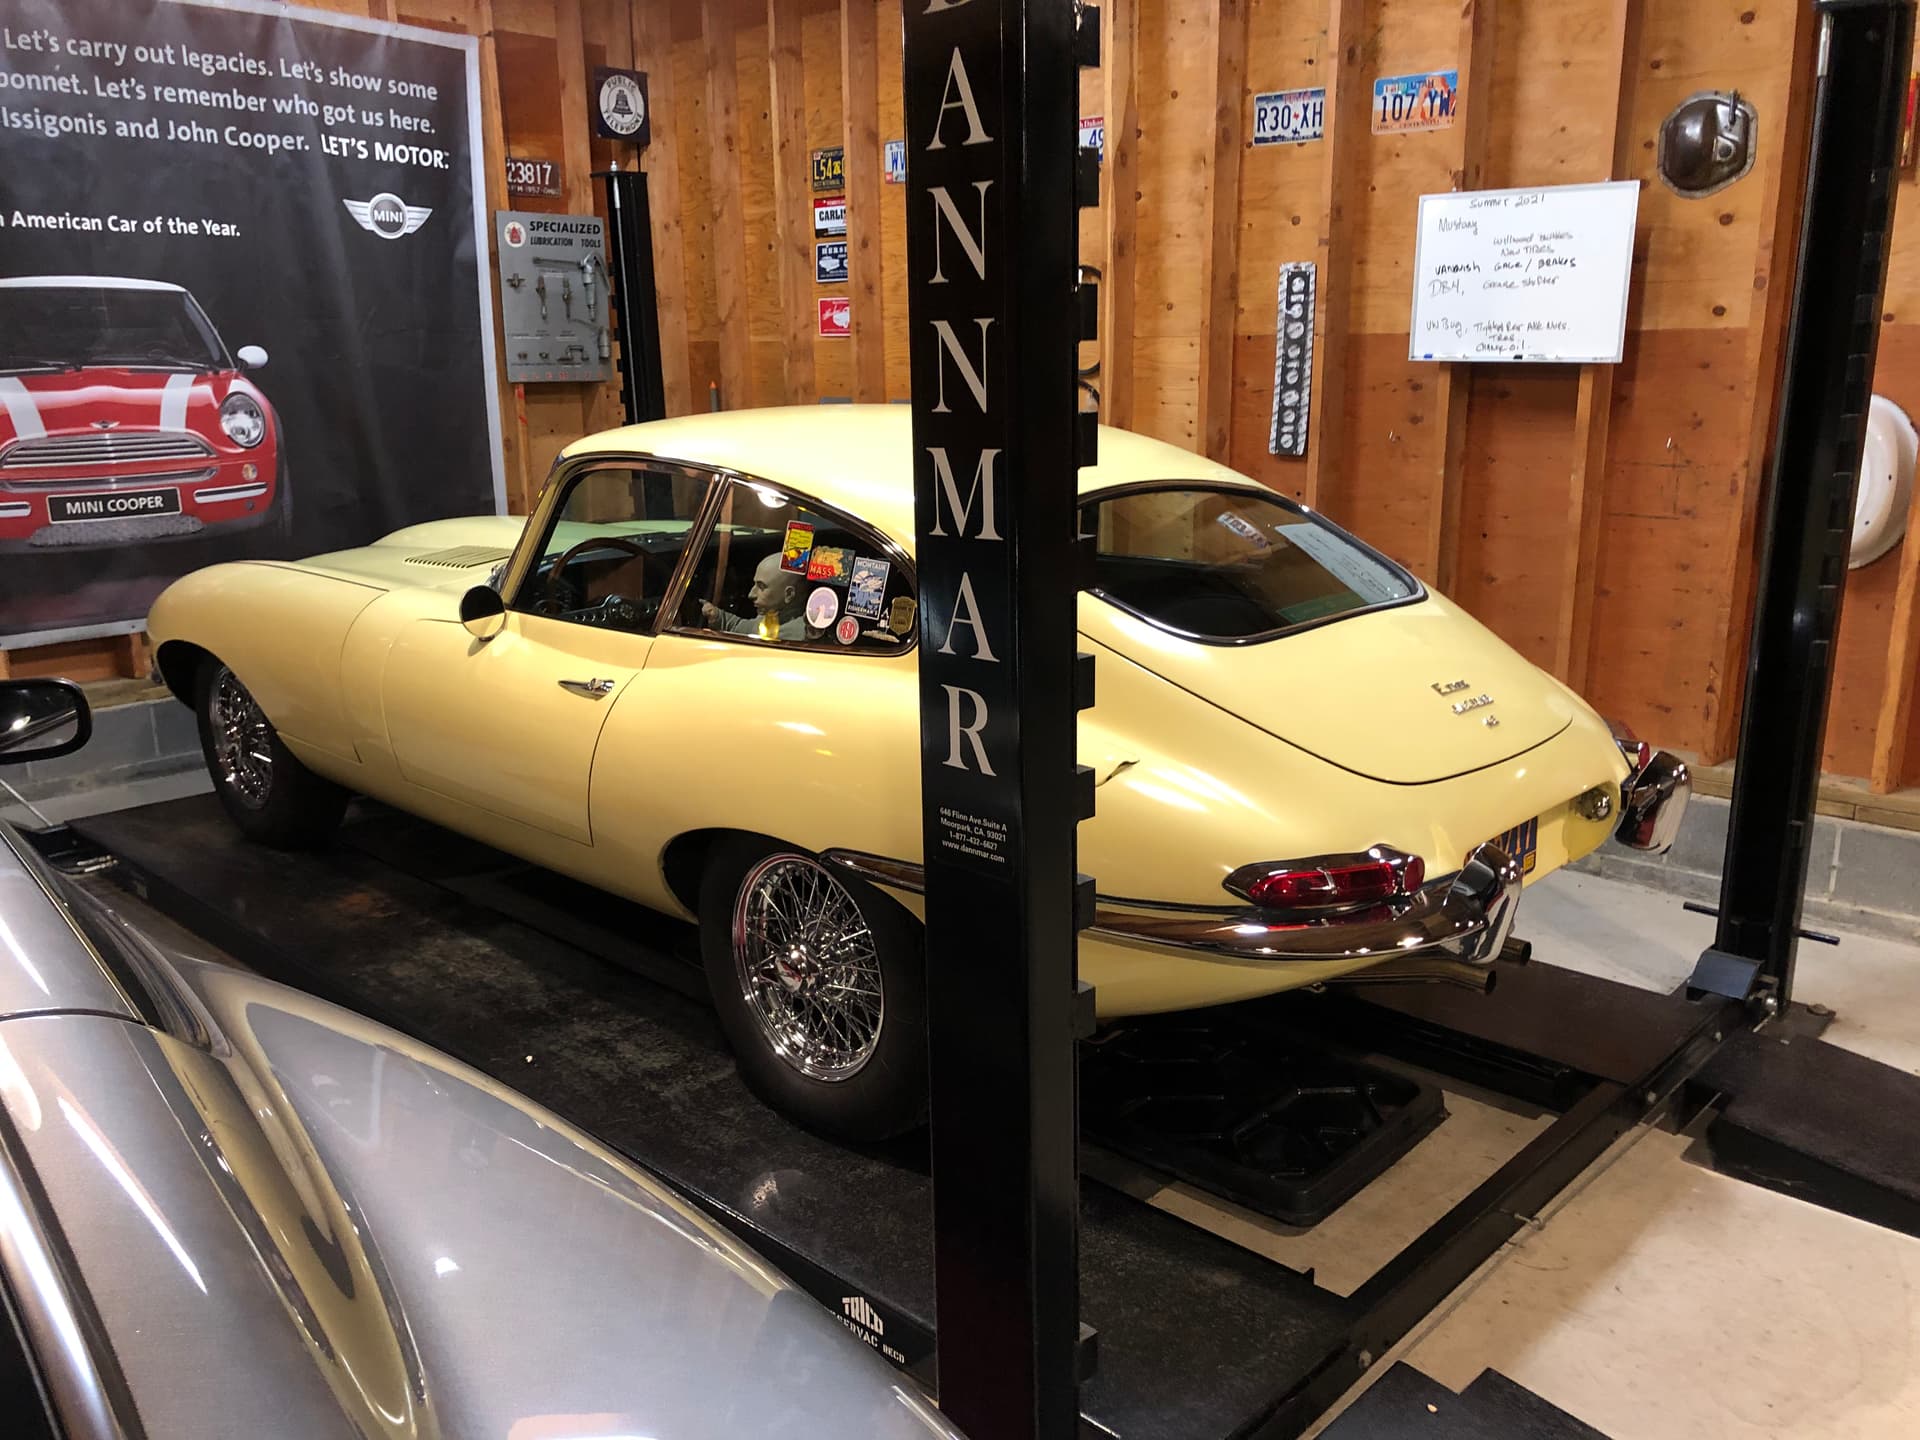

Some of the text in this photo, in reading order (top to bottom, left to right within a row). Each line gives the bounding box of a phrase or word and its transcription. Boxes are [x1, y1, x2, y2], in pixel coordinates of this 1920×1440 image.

[4, 28, 438, 101] Let's carry out legacies. Let's show some
[94, 75, 147, 101] Let's
[153, 84, 267, 113] remember
[272, 93, 319, 117] who
[322, 103, 356, 126] got
[361, 110, 384, 127] us
[389, 108, 436, 134] here.
[1381, 91, 1415, 122] 107
[1257, 104, 1292, 133] R30
[2, 106, 107, 138] Issigonis
[115, 117, 159, 140] and
[167, 119, 219, 144] John
[224, 126, 310, 155] Cooper.
[320, 133, 369, 160] LET'S
[11, 210, 103, 231] American
[107, 215, 137, 233] Car
[143, 216, 163, 234] of
[167, 216, 199, 235] the
[201, 218, 241, 237] Year.
[373, 209, 403, 223] MINI
[529, 220, 601, 235] SPECIALIZED
[530, 236, 602, 249] LUBRICATION TOOLS
[923, 0, 1004, 777] ANNMAR
[66, 496, 164, 515] MINI COOPER
[952, 810, 968, 821] Flinn
[1001, 823, 1007, 832] A
[986, 830, 1006, 843] 93021
